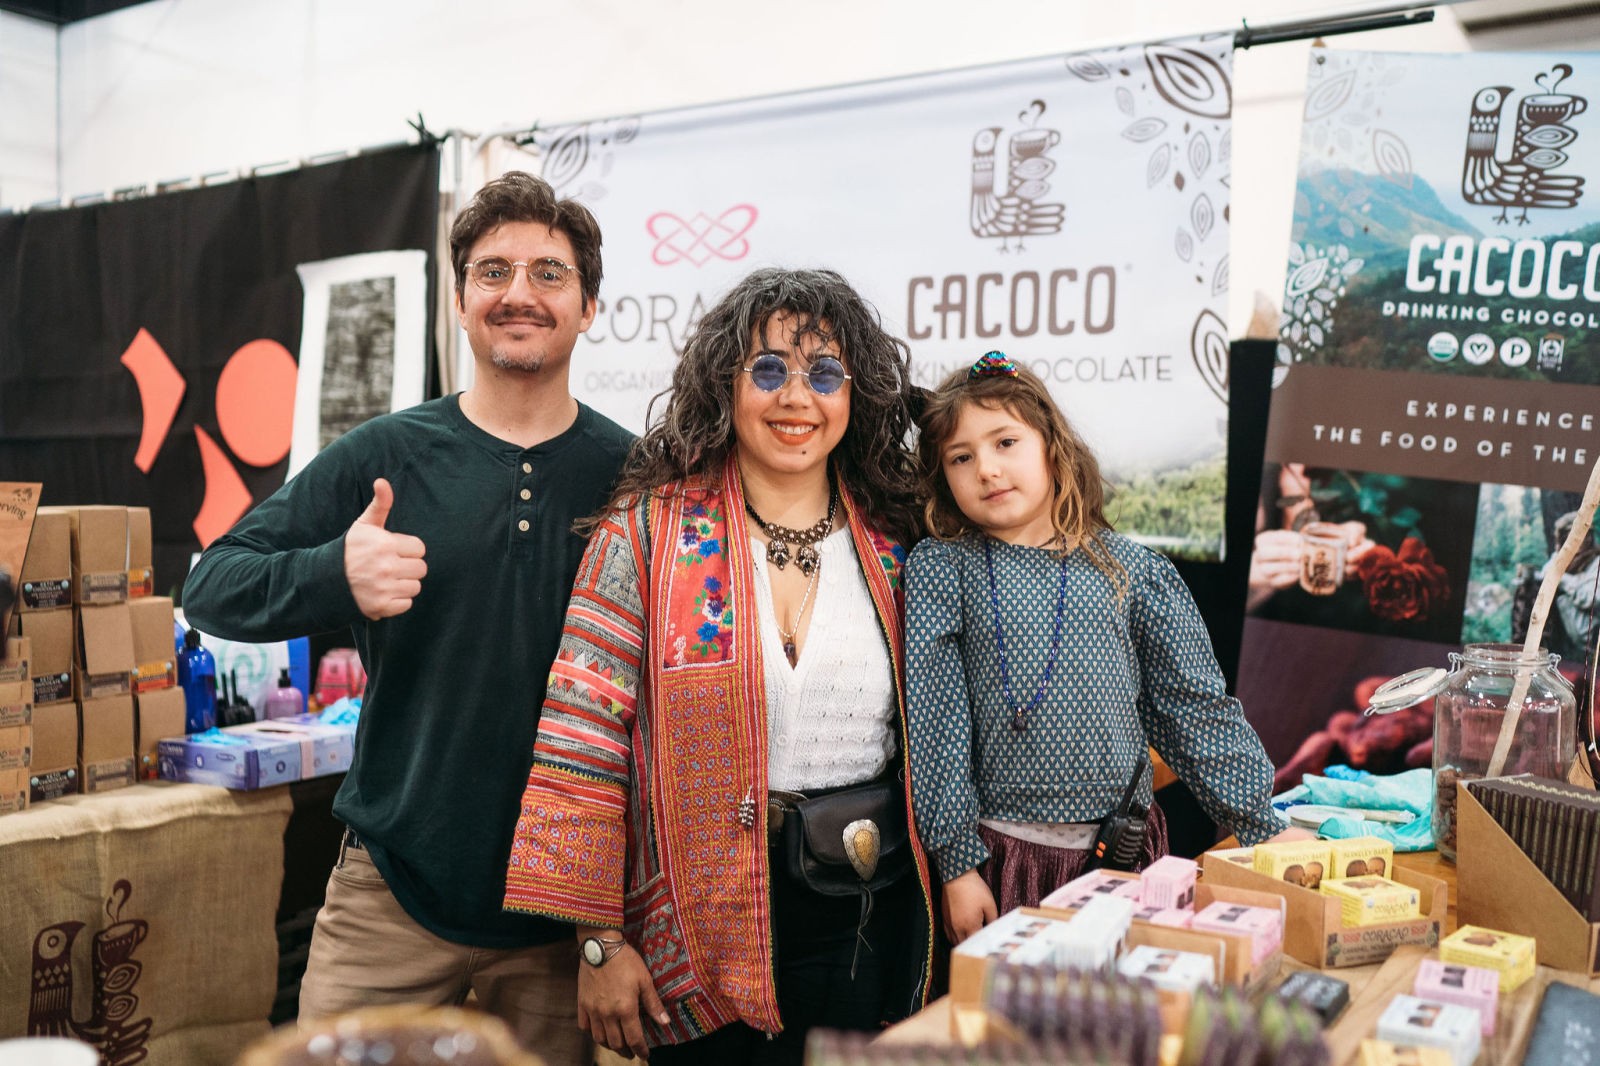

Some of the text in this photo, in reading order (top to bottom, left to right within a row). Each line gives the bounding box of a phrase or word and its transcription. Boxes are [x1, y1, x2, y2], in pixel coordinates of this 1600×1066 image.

[907, 266, 1116, 340] CACOCO
[1382, 301, 1600, 329] DRINKING CHOCOL
[584, 292, 708, 356] CORA
[1023, 355, 1173, 384] OCOLATE
[1406, 400, 1594, 431] EXPERIENCE
[1313, 425, 1587, 465] THE FOOD OF THE
